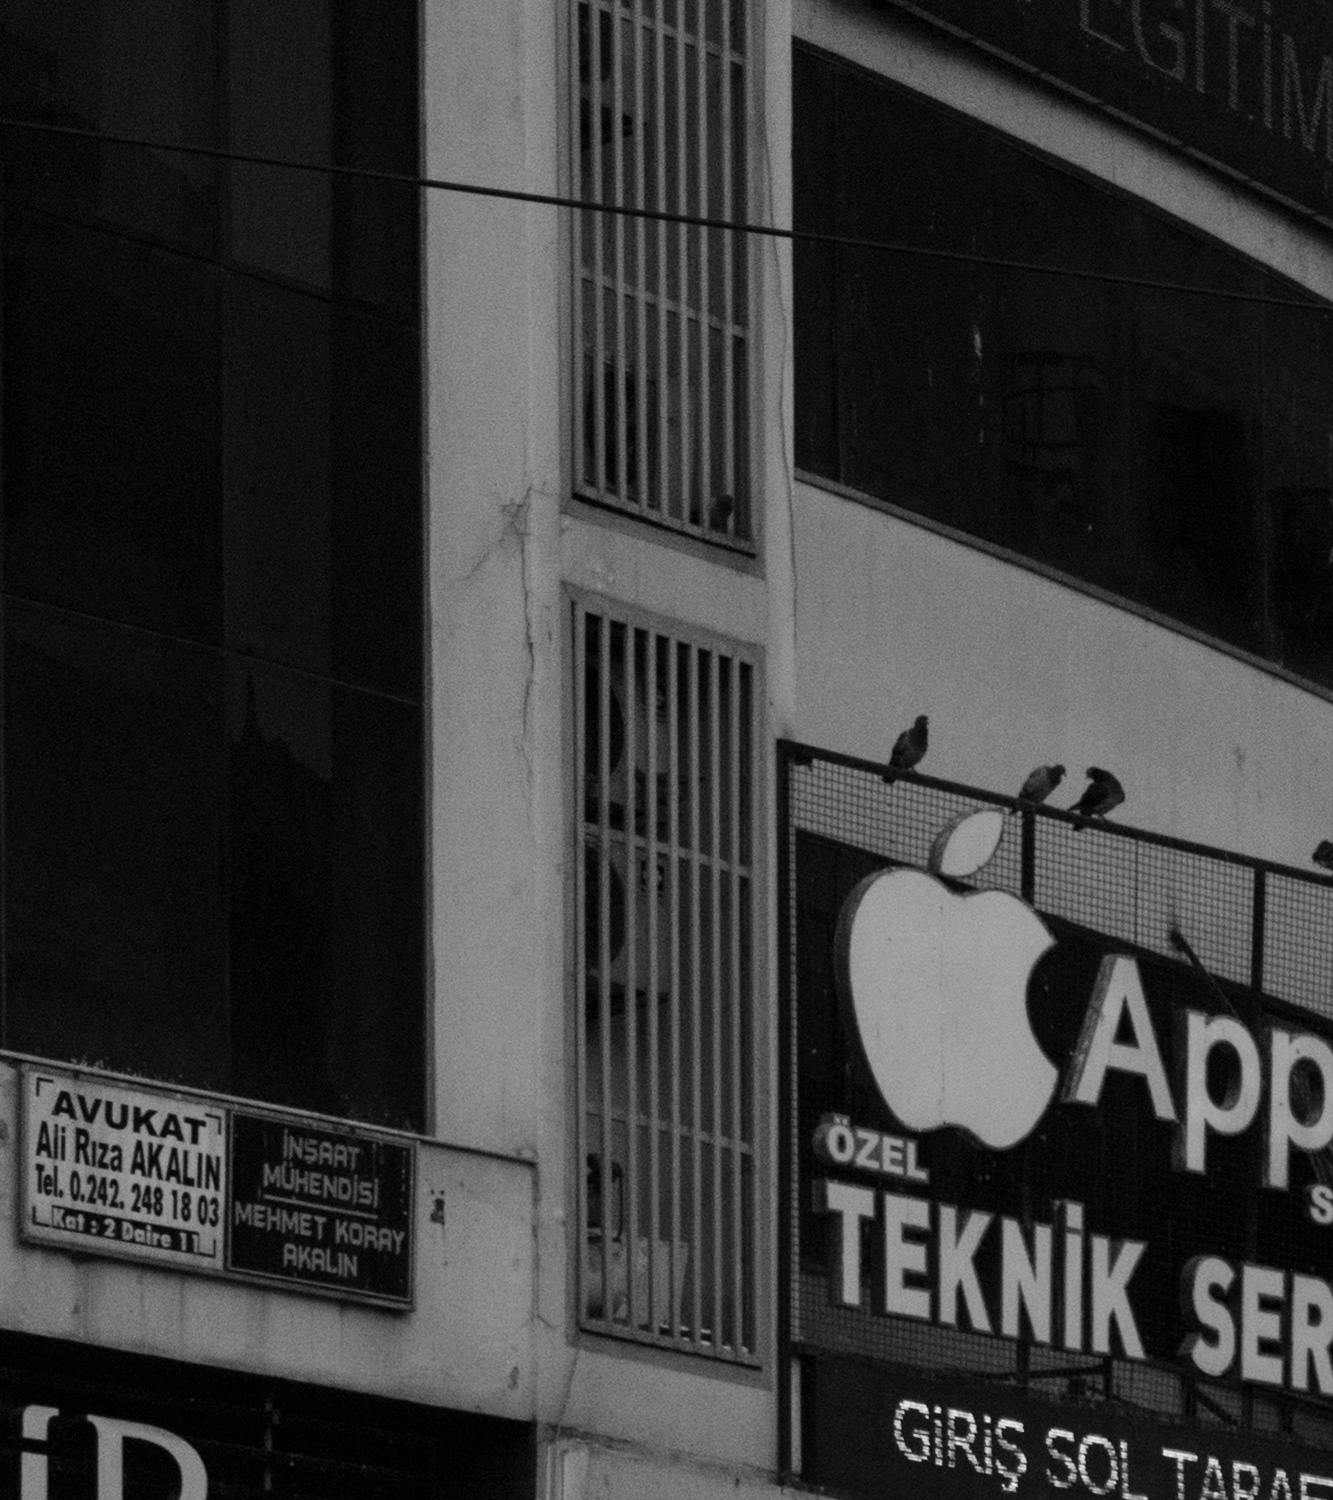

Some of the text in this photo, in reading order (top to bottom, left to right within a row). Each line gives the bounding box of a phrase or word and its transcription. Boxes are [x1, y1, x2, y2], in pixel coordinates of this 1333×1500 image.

[51, 1089, 207, 1146] AVUKAT
[824, 1113, 929, 1182] ÖZEL
[34, 1120, 67, 1161] Ali
[130, 1139, 222, 1193] AKALIN
[34, 1162, 66, 1200] Tel.
[130, 1183, 165, 1217] 248
[171, 1189, 193, 1223] 18
[196, 1194, 221, 1229] 03
[51, 1205, 85, 1232] Kat
[122, 1218, 173, 1248] Daire
[233, 1201, 405, 1256] MEHMET KORAY
[281, 1244, 359, 1278] AKALIN
[825, 1177, 1149, 1361] TEKNİK
